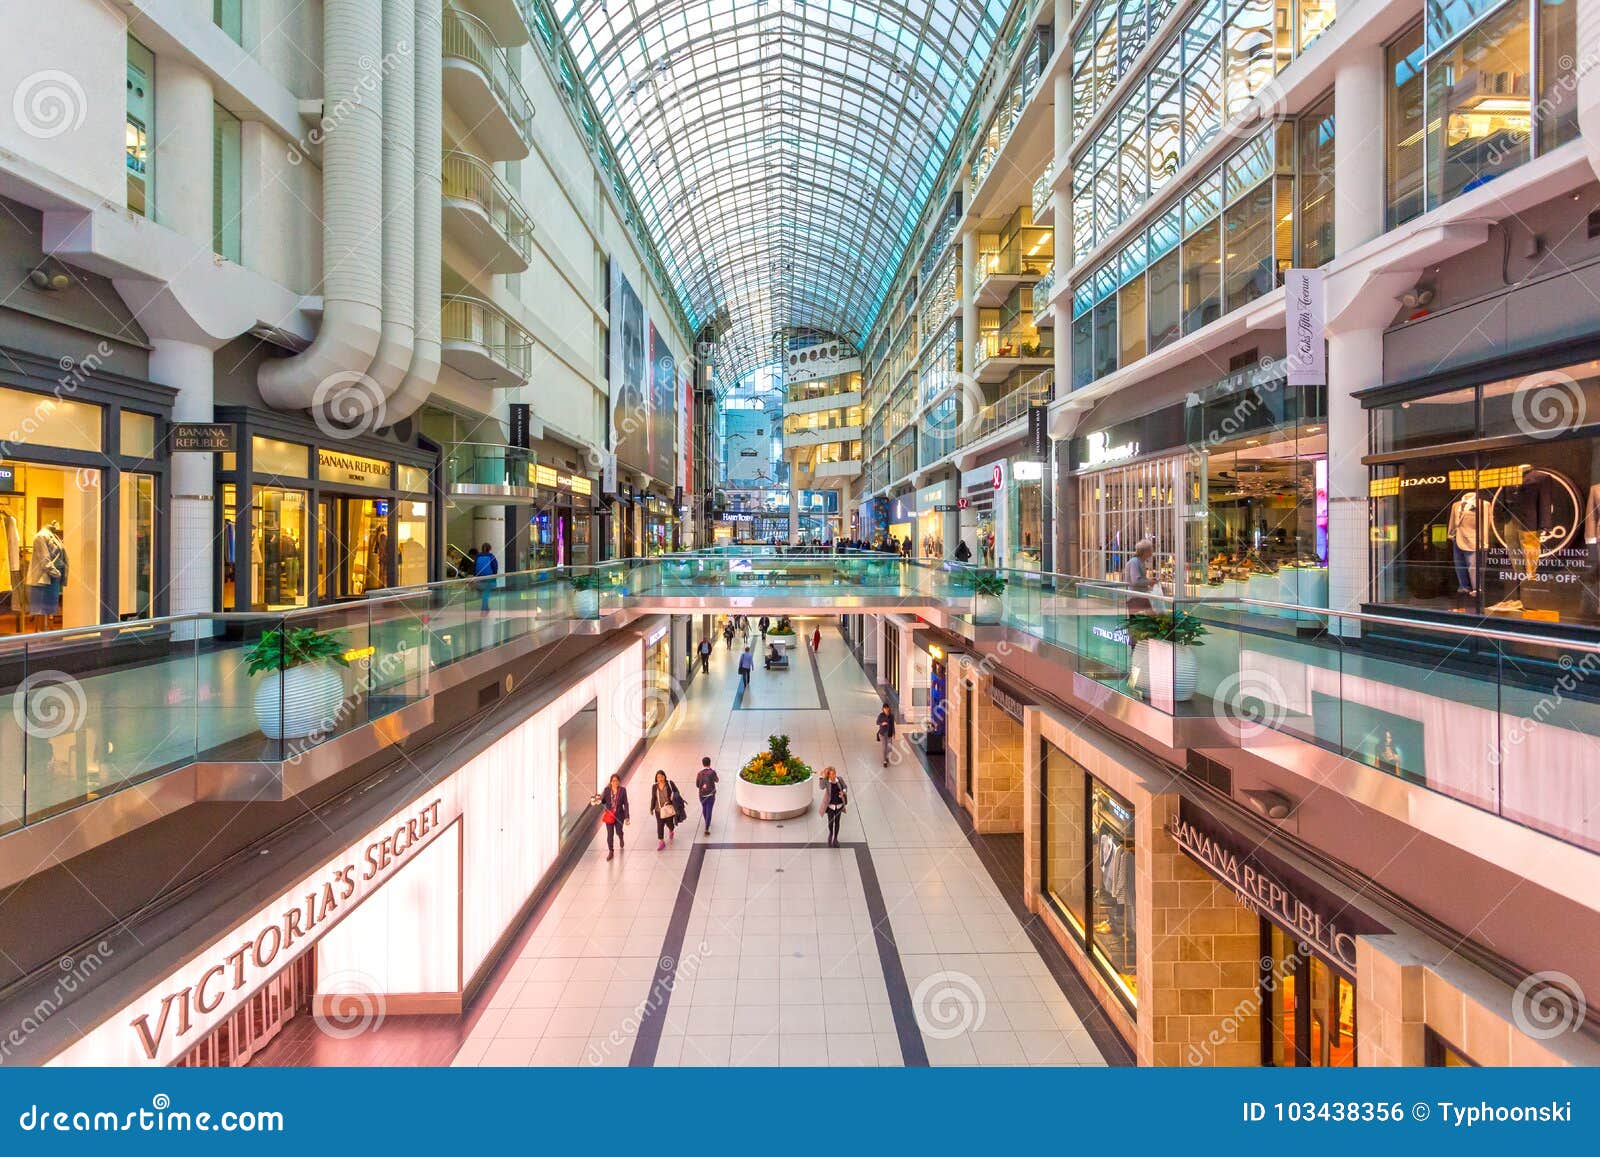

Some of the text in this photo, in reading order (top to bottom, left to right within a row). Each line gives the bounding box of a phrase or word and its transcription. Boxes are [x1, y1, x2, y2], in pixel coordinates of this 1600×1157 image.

[178, 427, 225, 437] BANANA
[176, 438, 229, 448] REPUBLIC
[319, 453, 390, 476] BANANA REPUBLIC
[1489, 547, 1508, 556] JUST
[1557, 549, 1589, 557] THING
[1499, 571, 1532, 581] ENJOY
[1171, 814, 1357, 968] BANANA REPUBLIC
[1234, 889, 1259, 916] MEN
[129, 798, 442, 1060] VICTORIA'S SECRET
